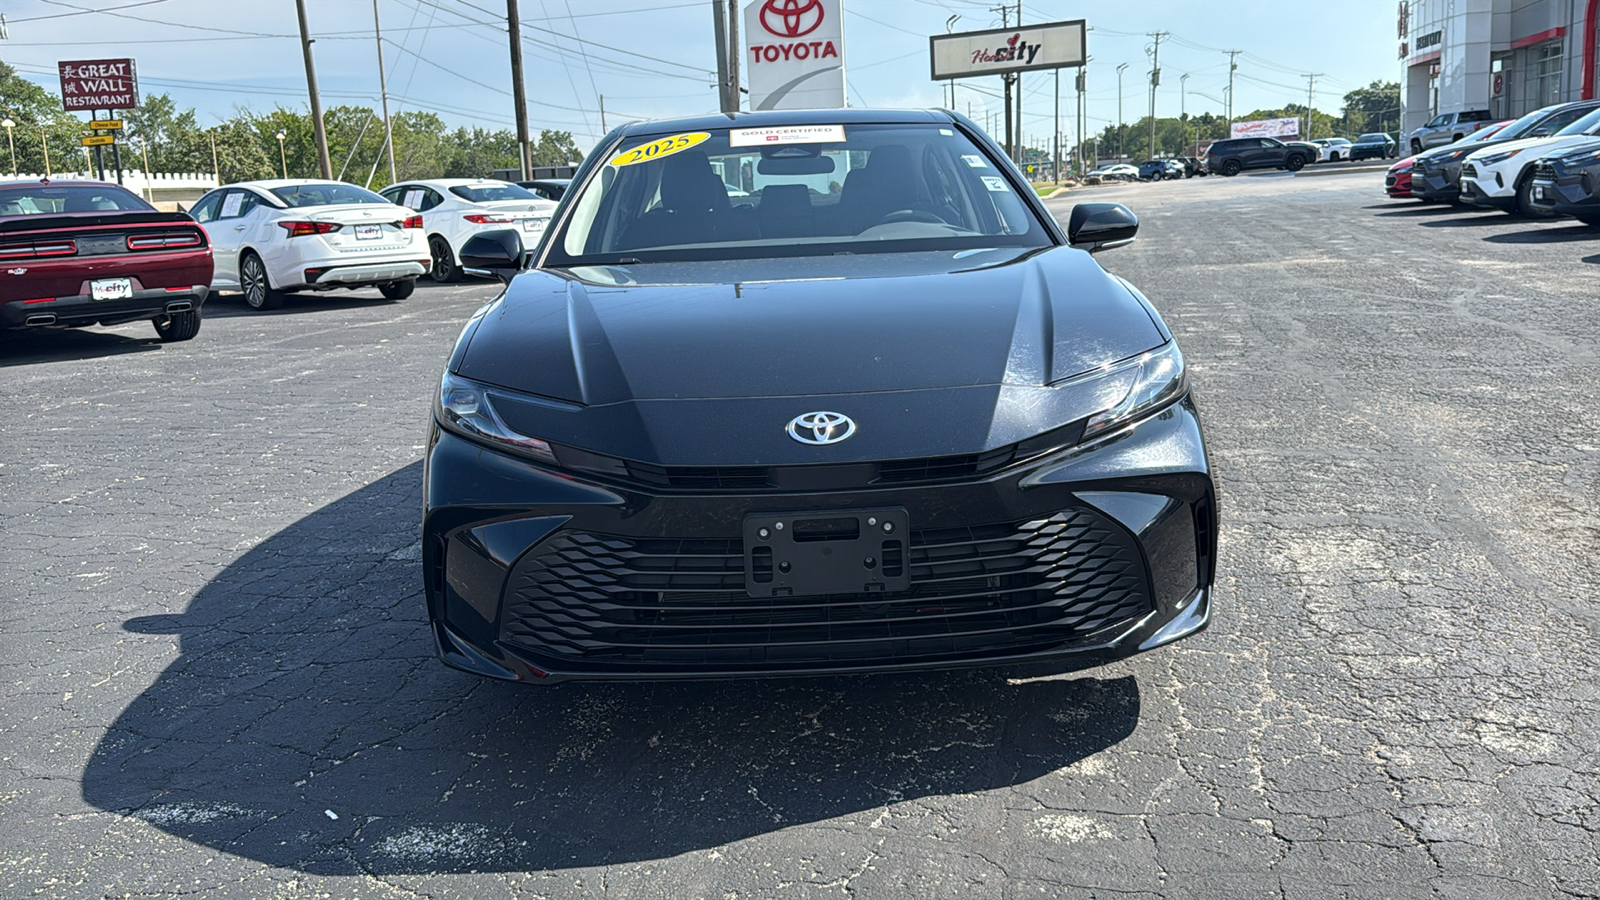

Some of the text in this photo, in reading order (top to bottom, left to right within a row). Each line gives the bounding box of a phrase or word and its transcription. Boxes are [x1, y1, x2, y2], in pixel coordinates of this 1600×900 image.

[750, 40, 838, 63] TOYOTA
[78, 63, 126, 78] GREAT
[80, 79, 127, 93] WALL
[65, 95, 131, 106] RESTAURANT
[629, 135, 690, 162] 2025
